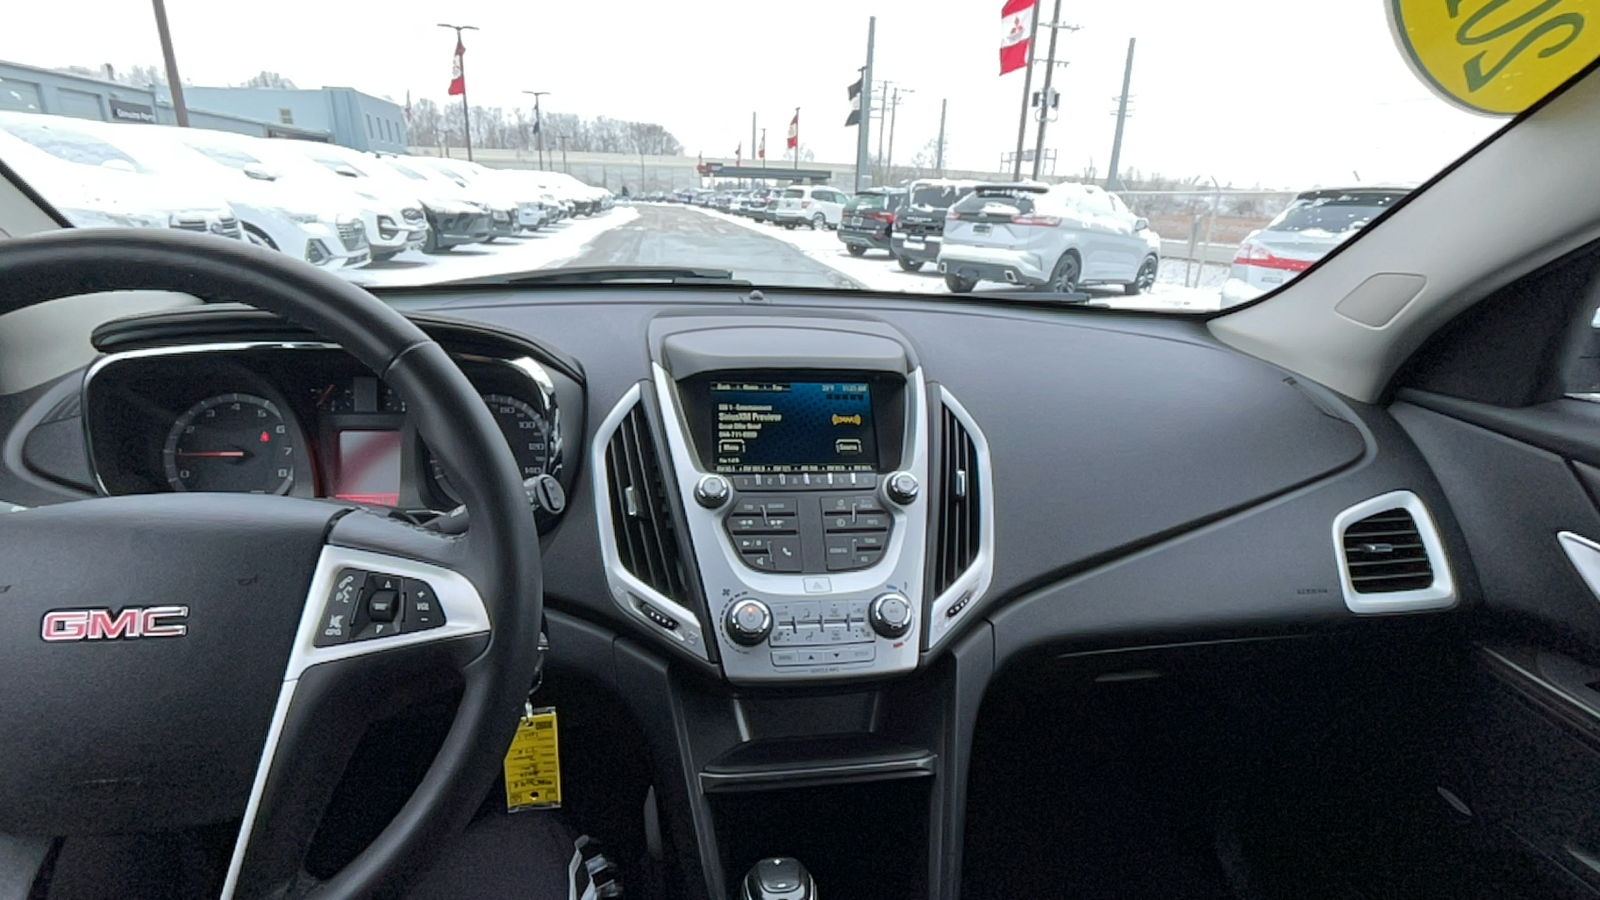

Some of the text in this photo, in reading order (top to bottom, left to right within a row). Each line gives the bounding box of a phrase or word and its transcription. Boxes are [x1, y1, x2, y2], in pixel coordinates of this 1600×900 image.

[206, 409, 216, 418] 3
[275, 425, 286, 434] 6
[519, 421, 536, 429] 100
[283, 447, 293, 456] 7
[180, 470, 190, 478] 0
[277, 468, 288, 478] 8
[42, 606, 189, 641] GMC
